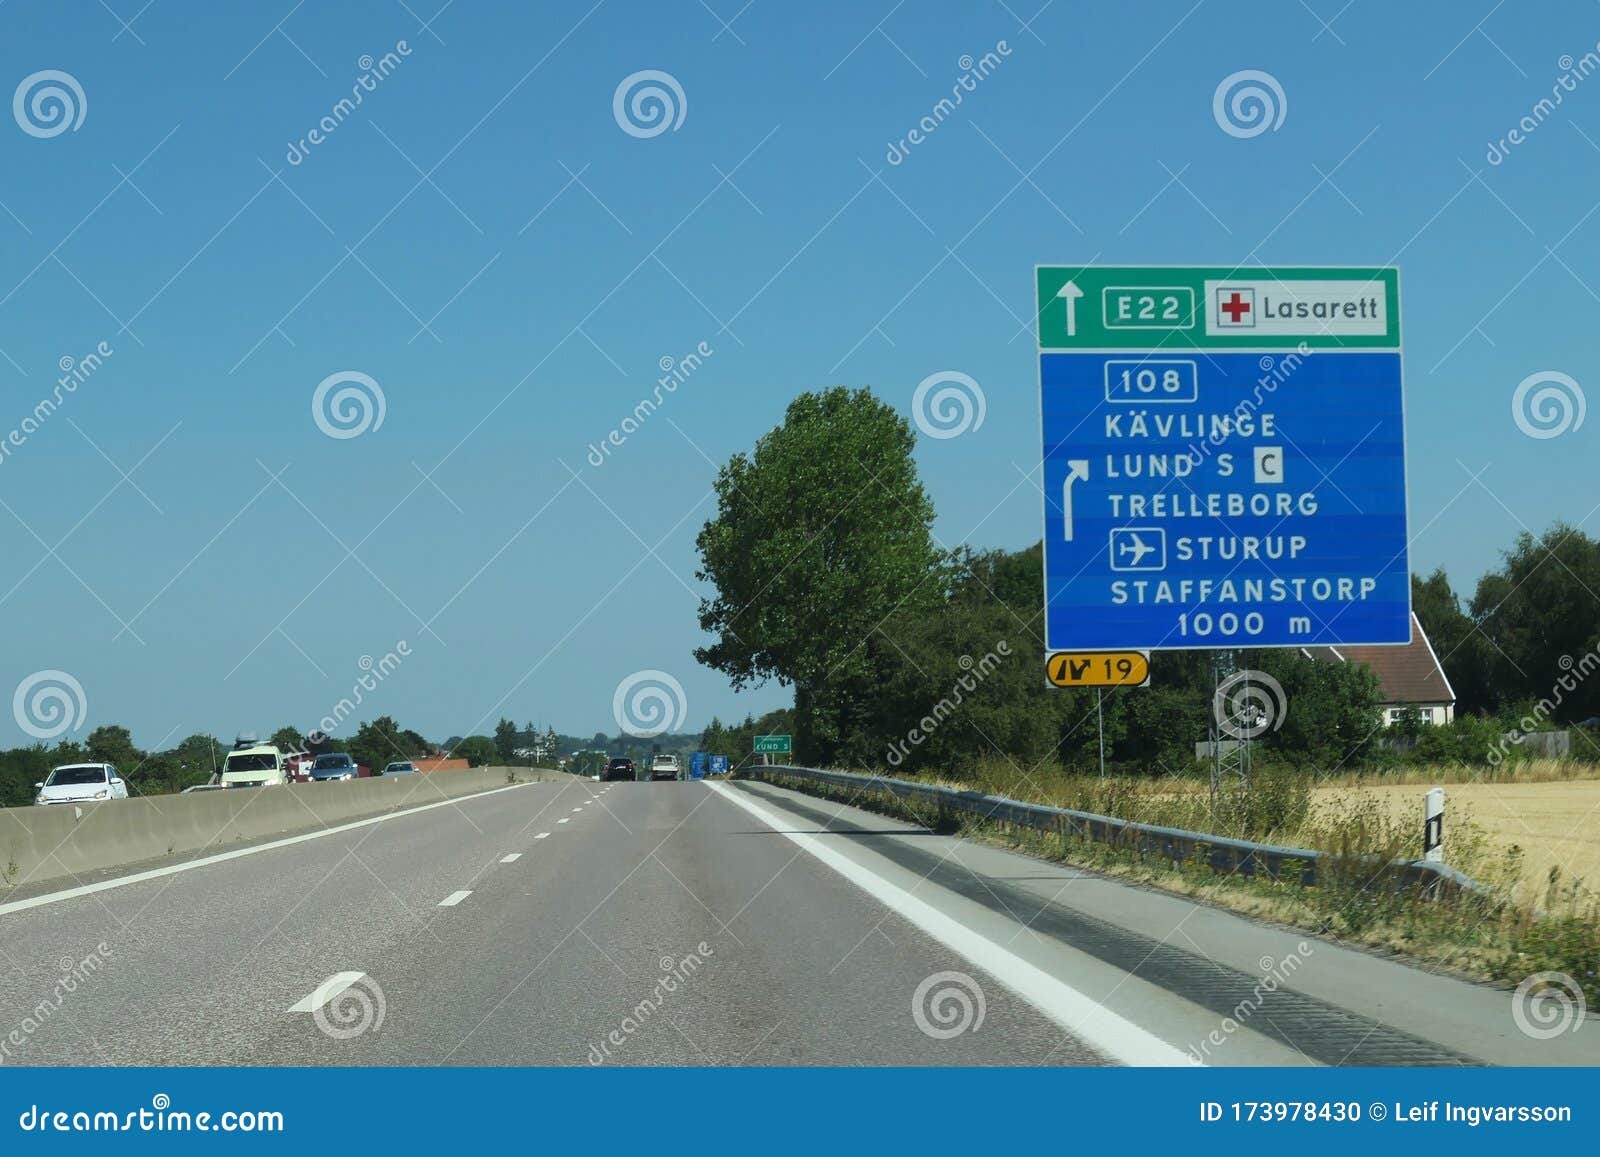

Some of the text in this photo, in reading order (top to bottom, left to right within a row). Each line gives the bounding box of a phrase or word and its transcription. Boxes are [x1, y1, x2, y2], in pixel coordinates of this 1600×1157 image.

[1118, 297, 1180, 320] E22
[1264, 294, 1378, 320] Lasarett
[1120, 369, 1181, 394] 108
[1106, 410, 1276, 438] KÄVLINGE
[1106, 453, 1277, 478] LUND S C
[1108, 493, 1319, 518] TRELLEBORG
[1176, 536, 1307, 560] STURUP
[1111, 578, 1377, 604] STAFFANSTORP
[1178, 612, 1312, 636] 1000 m
[1104, 659, 1133, 681] 19
